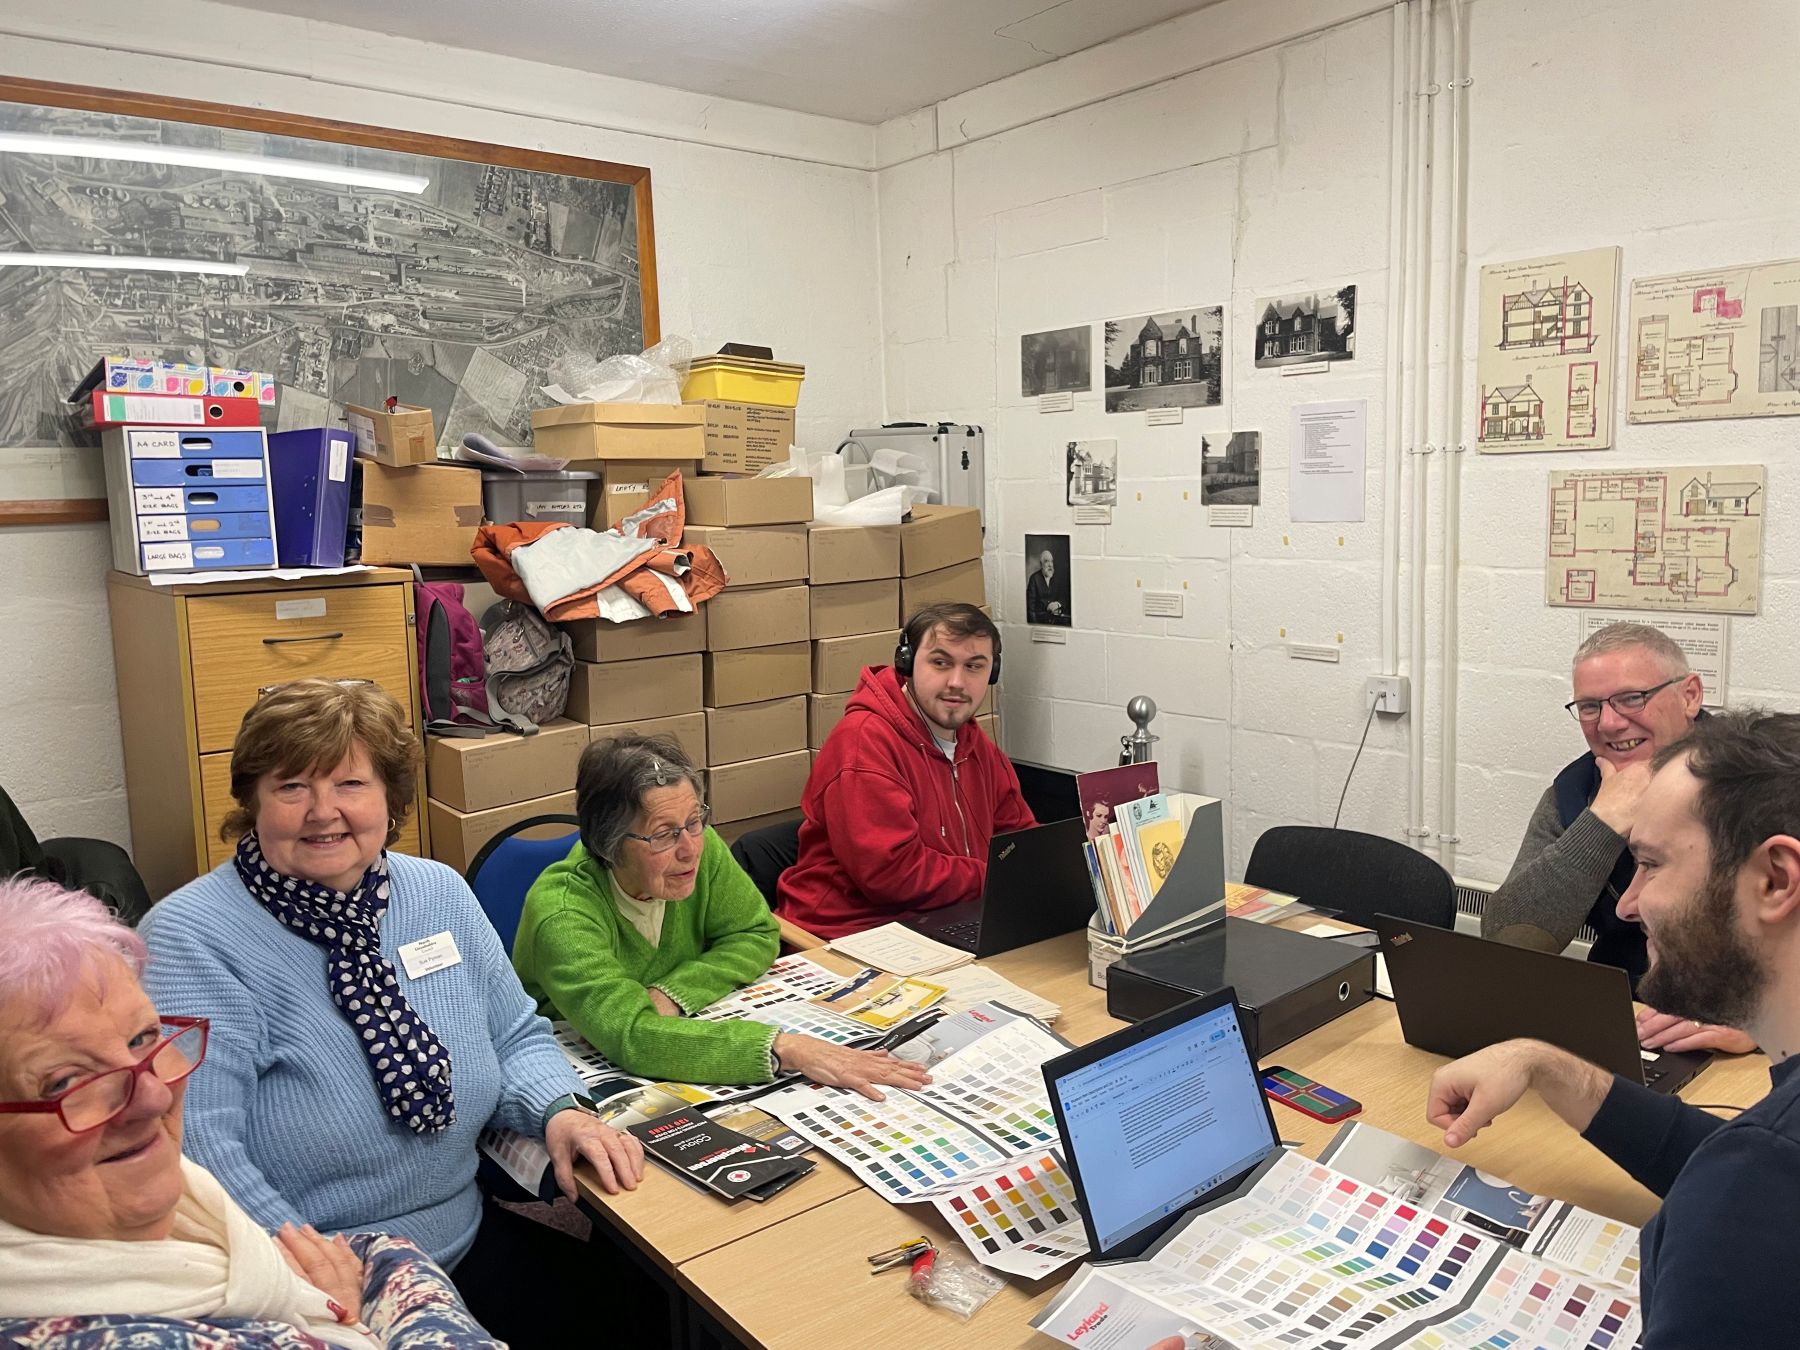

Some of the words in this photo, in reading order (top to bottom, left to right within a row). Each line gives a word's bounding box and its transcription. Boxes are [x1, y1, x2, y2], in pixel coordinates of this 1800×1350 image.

[151, 440, 176, 448] CARD
[147, 553, 167, 561] LARGE
[167, 552, 187, 561] BAGS
[648, 1122, 674, 1135] YEARS
[679, 1135, 712, 1151] Colour
[1066, 1301, 1110, 1341] Leyland
[1090, 1314, 1109, 1331] Trade
